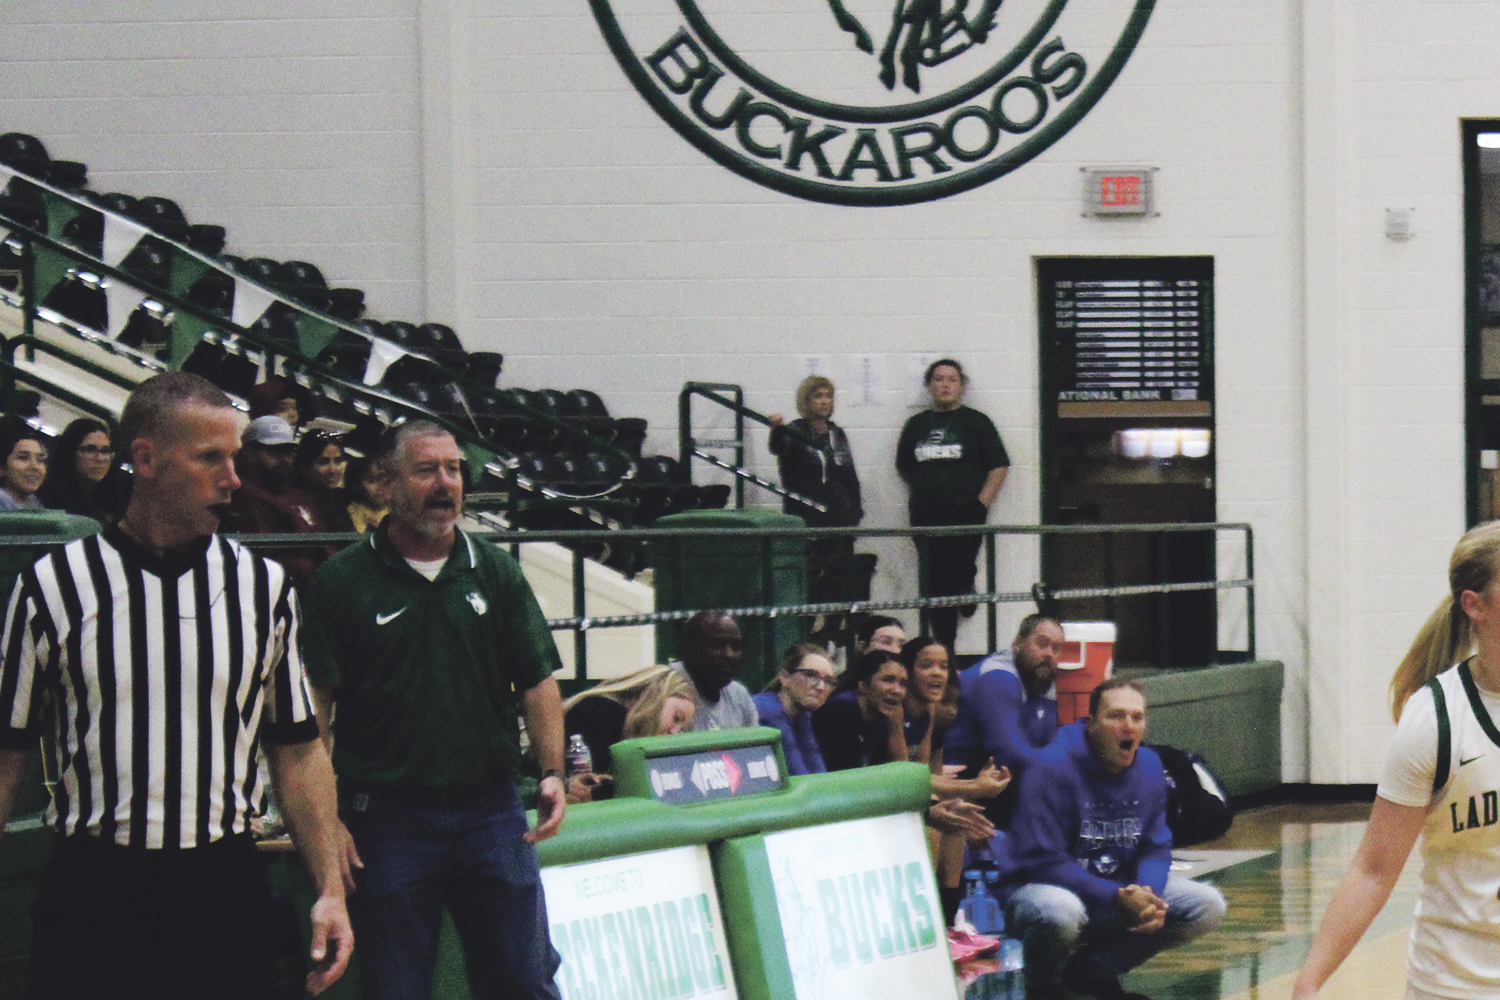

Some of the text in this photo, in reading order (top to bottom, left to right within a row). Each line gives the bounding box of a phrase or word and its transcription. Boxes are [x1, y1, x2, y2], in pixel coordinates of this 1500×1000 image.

[644, 26, 1088, 183] BUCKAROOS
[1058, 390, 1119, 401] ATIONAL
[571, 868, 644, 900] WELCOME TO
[815, 861, 937, 971] BUCKS
